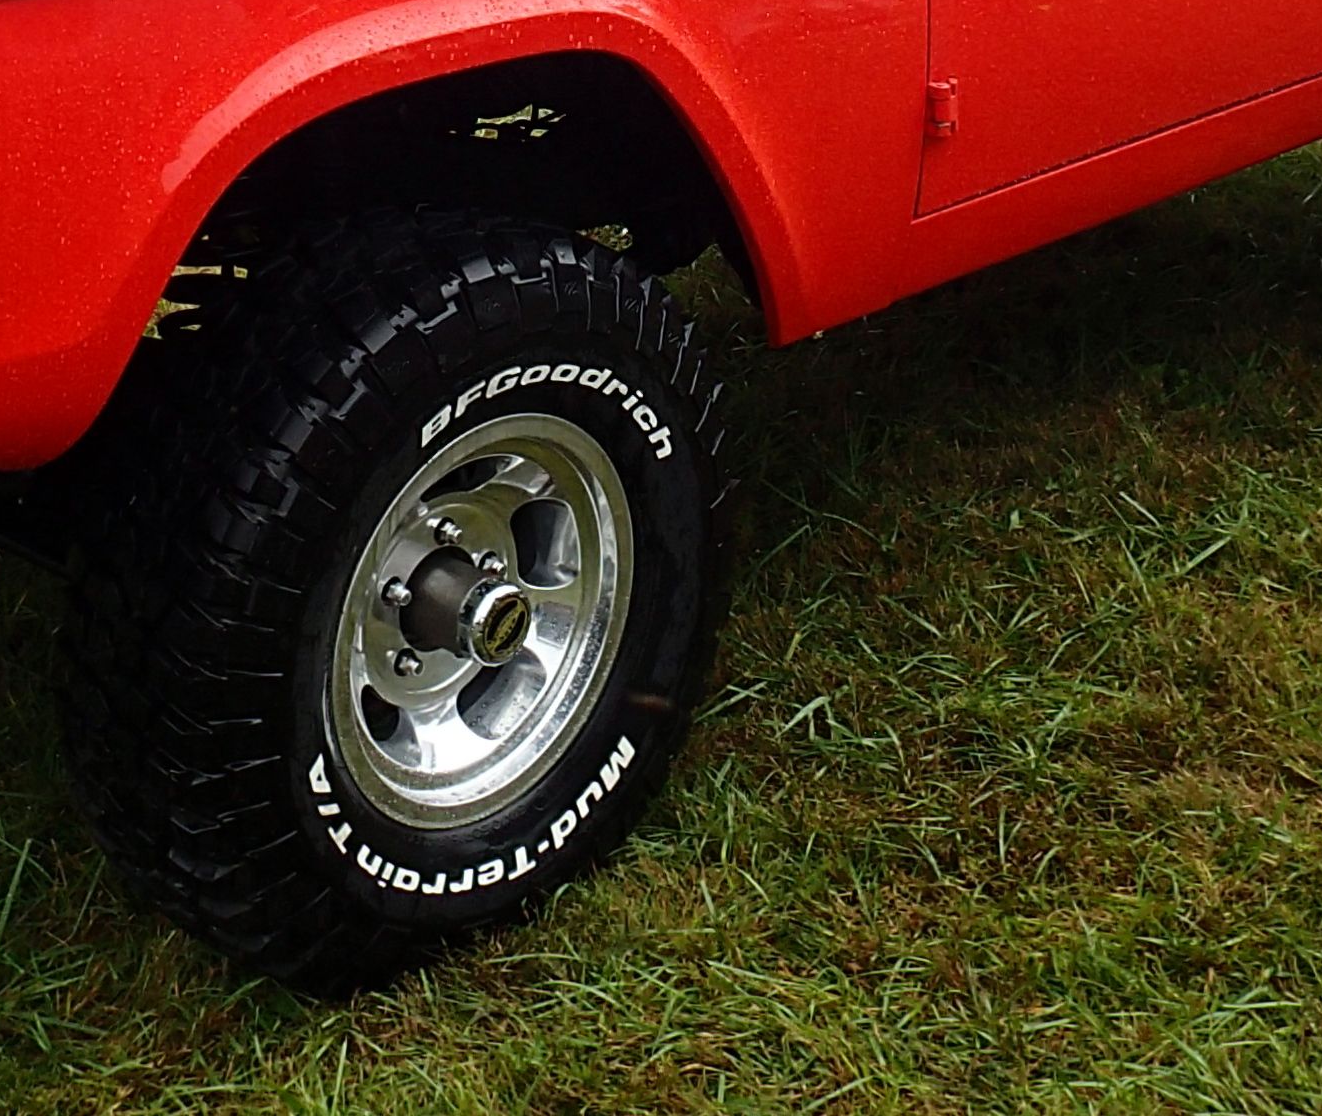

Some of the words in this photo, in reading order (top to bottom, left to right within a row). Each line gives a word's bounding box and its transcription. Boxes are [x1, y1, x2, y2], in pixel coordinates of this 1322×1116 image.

[421, 363, 674, 461] BFGoodrich
[308, 752, 353, 854] T/A
[356, 735, 637, 895] Mud-Terrain
